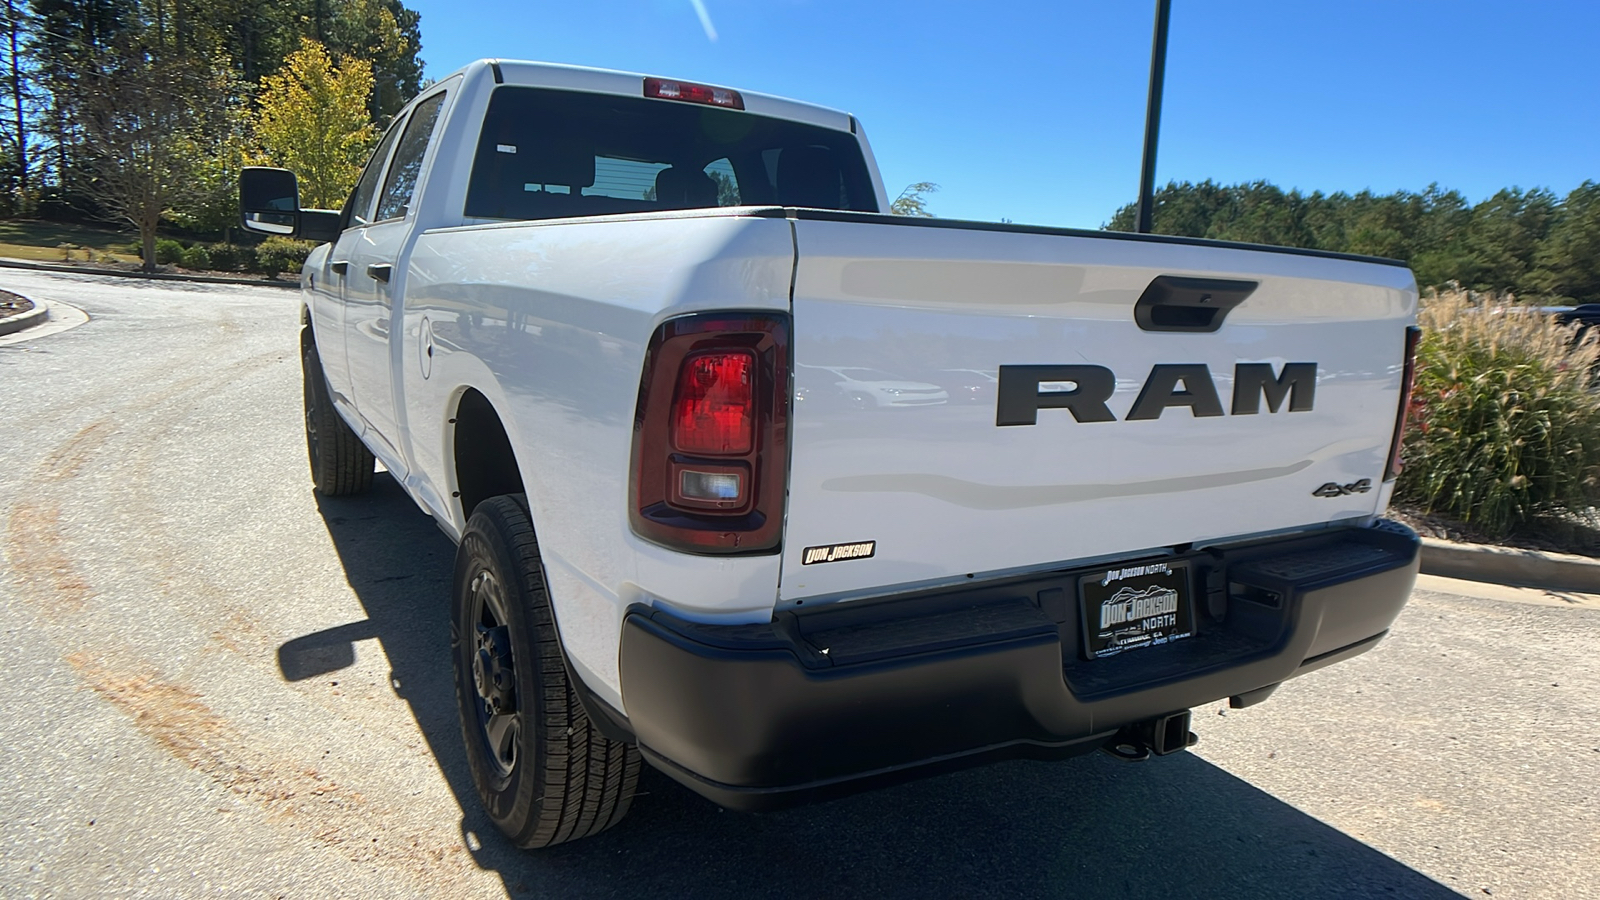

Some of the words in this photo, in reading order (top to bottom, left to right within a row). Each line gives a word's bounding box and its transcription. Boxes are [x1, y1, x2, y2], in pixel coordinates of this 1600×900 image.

[996, 362, 1318, 427] RAM
[827, 543, 874, 562] JACKSON
[1144, 563, 1168, 575] NORTH
[1101, 602, 1127, 629] DON
[1127, 593, 1178, 621] JACKSON
[1143, 614, 1176, 630] NORTH
